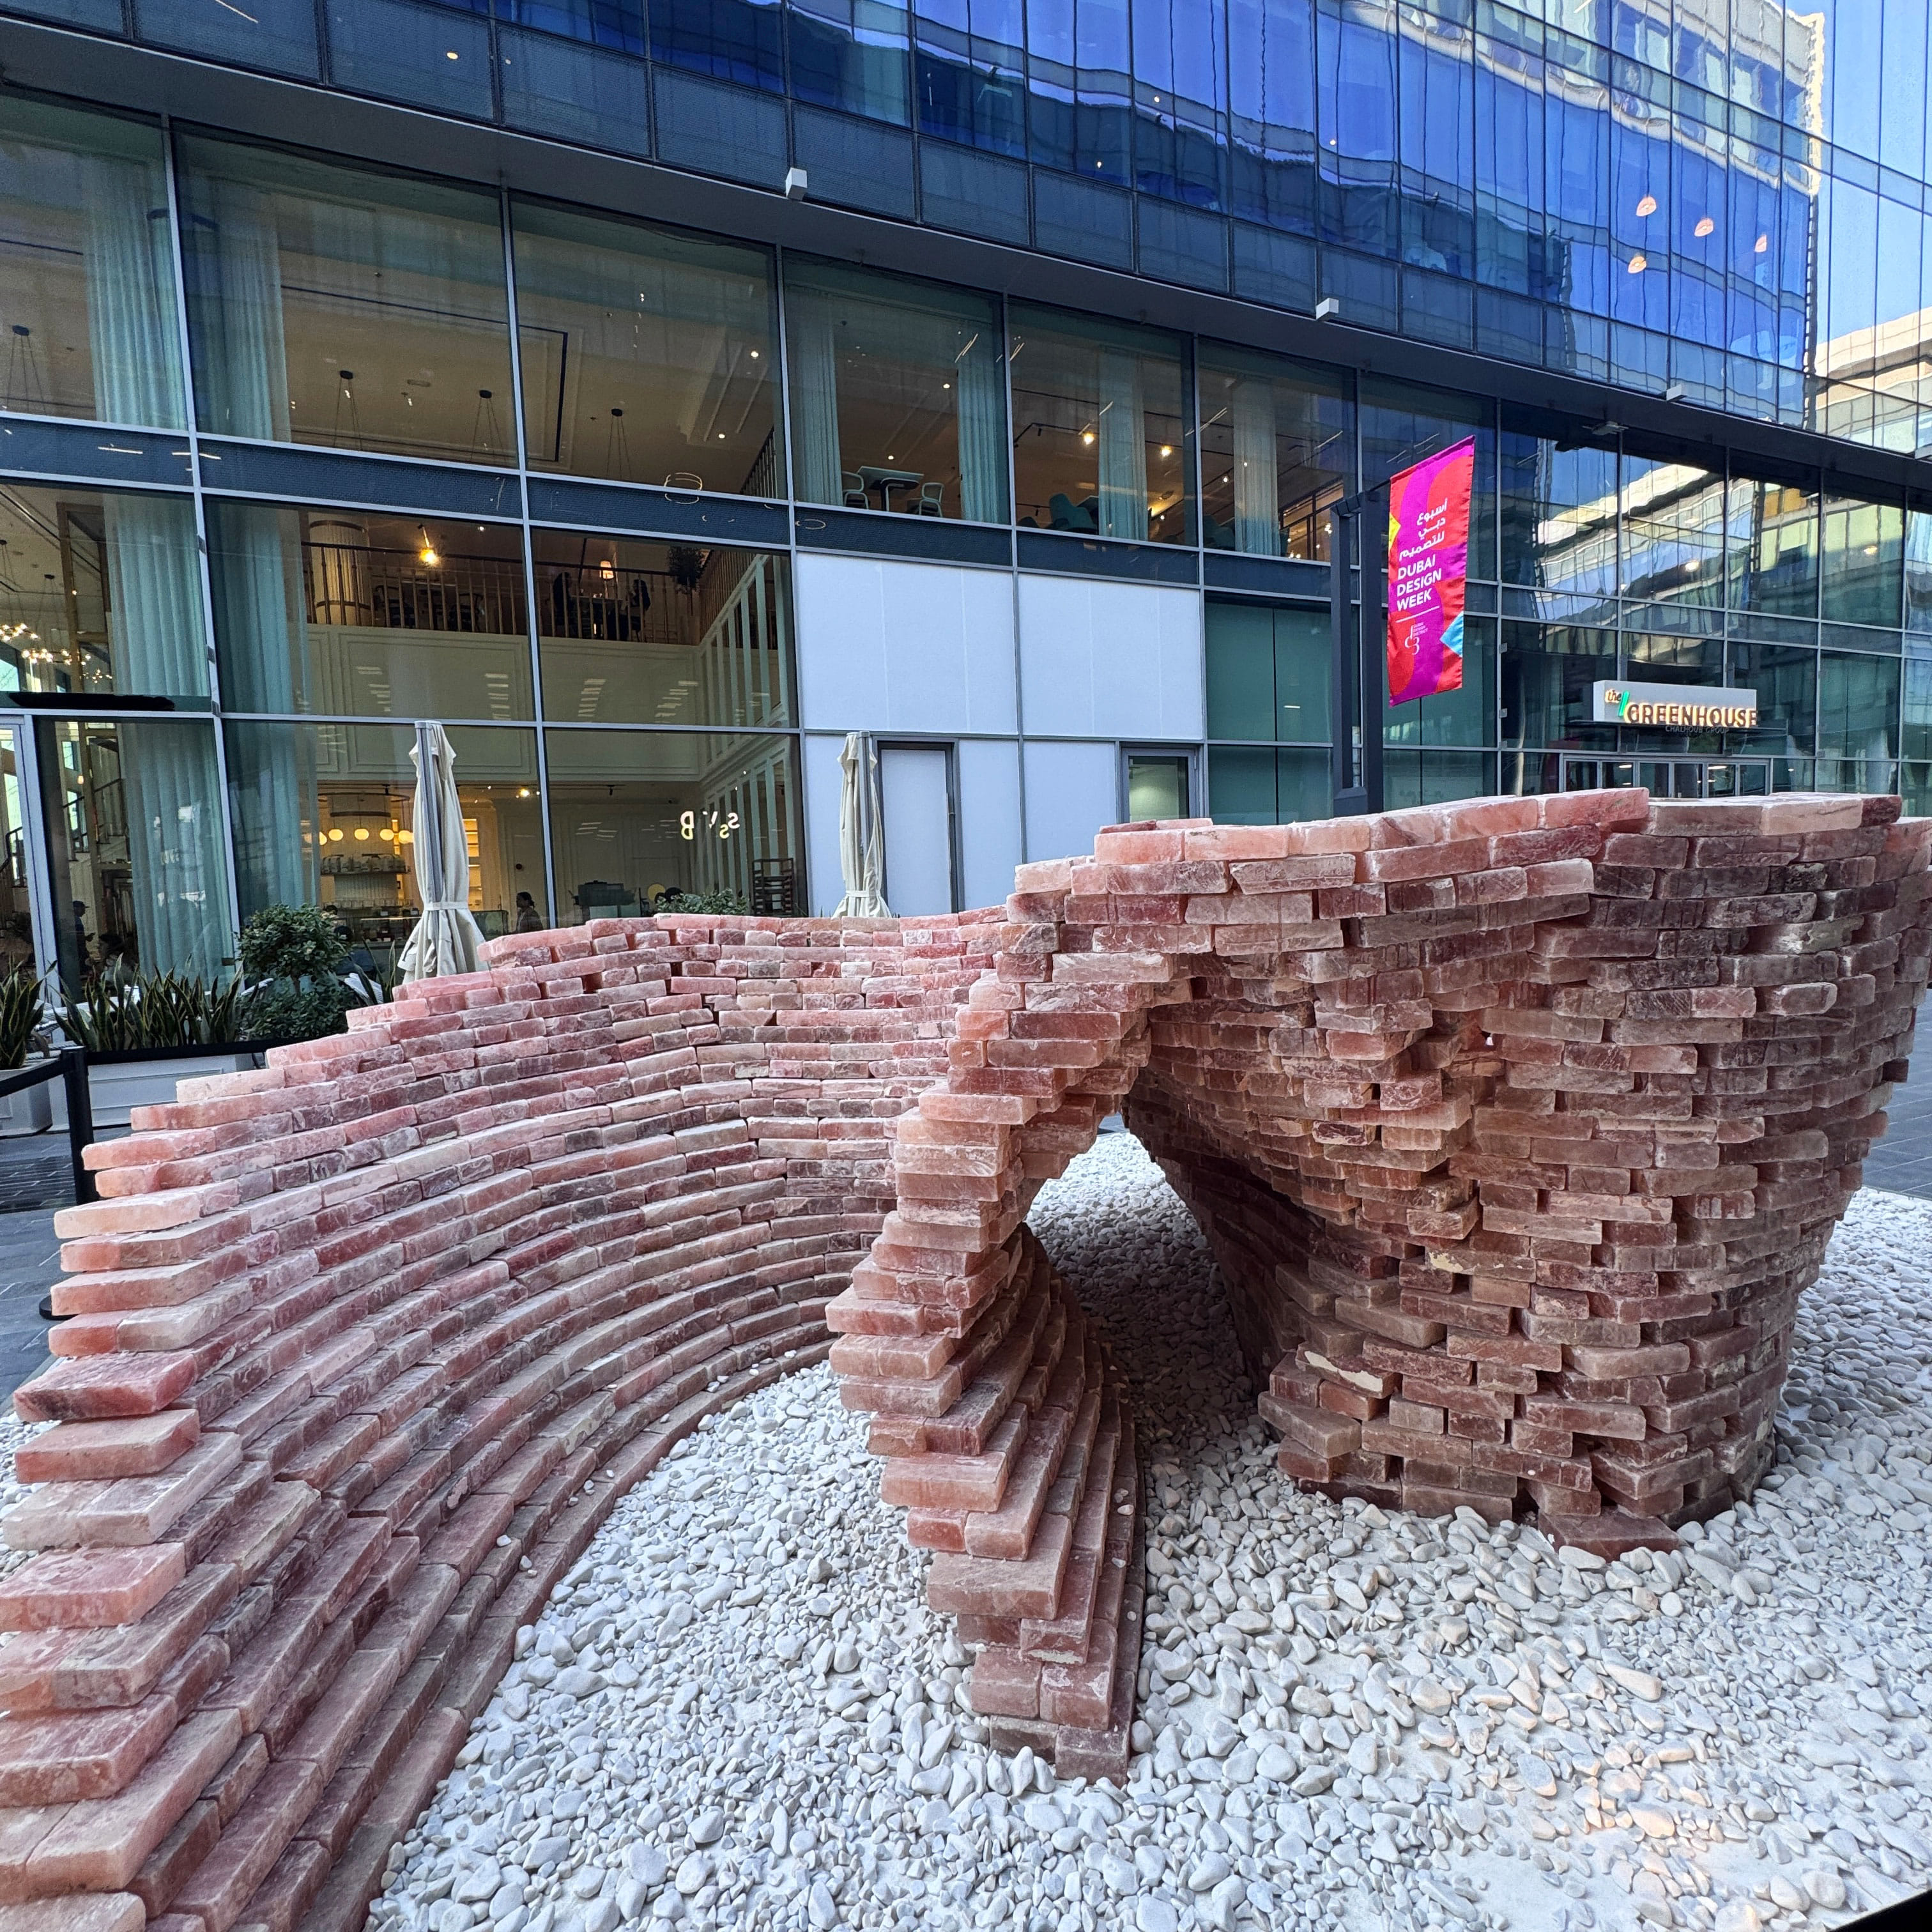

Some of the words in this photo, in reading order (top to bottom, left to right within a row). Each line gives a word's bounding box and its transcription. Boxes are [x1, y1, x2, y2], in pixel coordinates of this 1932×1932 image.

[1418, 518, 1446, 541] دبي
[1399, 531, 1445, 562] للتصميم
[1397, 553, 1436, 581] DUBAI
[1397, 567, 1442, 597] DESIGN
[1397, 587, 1432, 611] WEEK
[1606, 689, 1621, 702] the
[1626, 703, 1758, 727] GREENHOUSE
